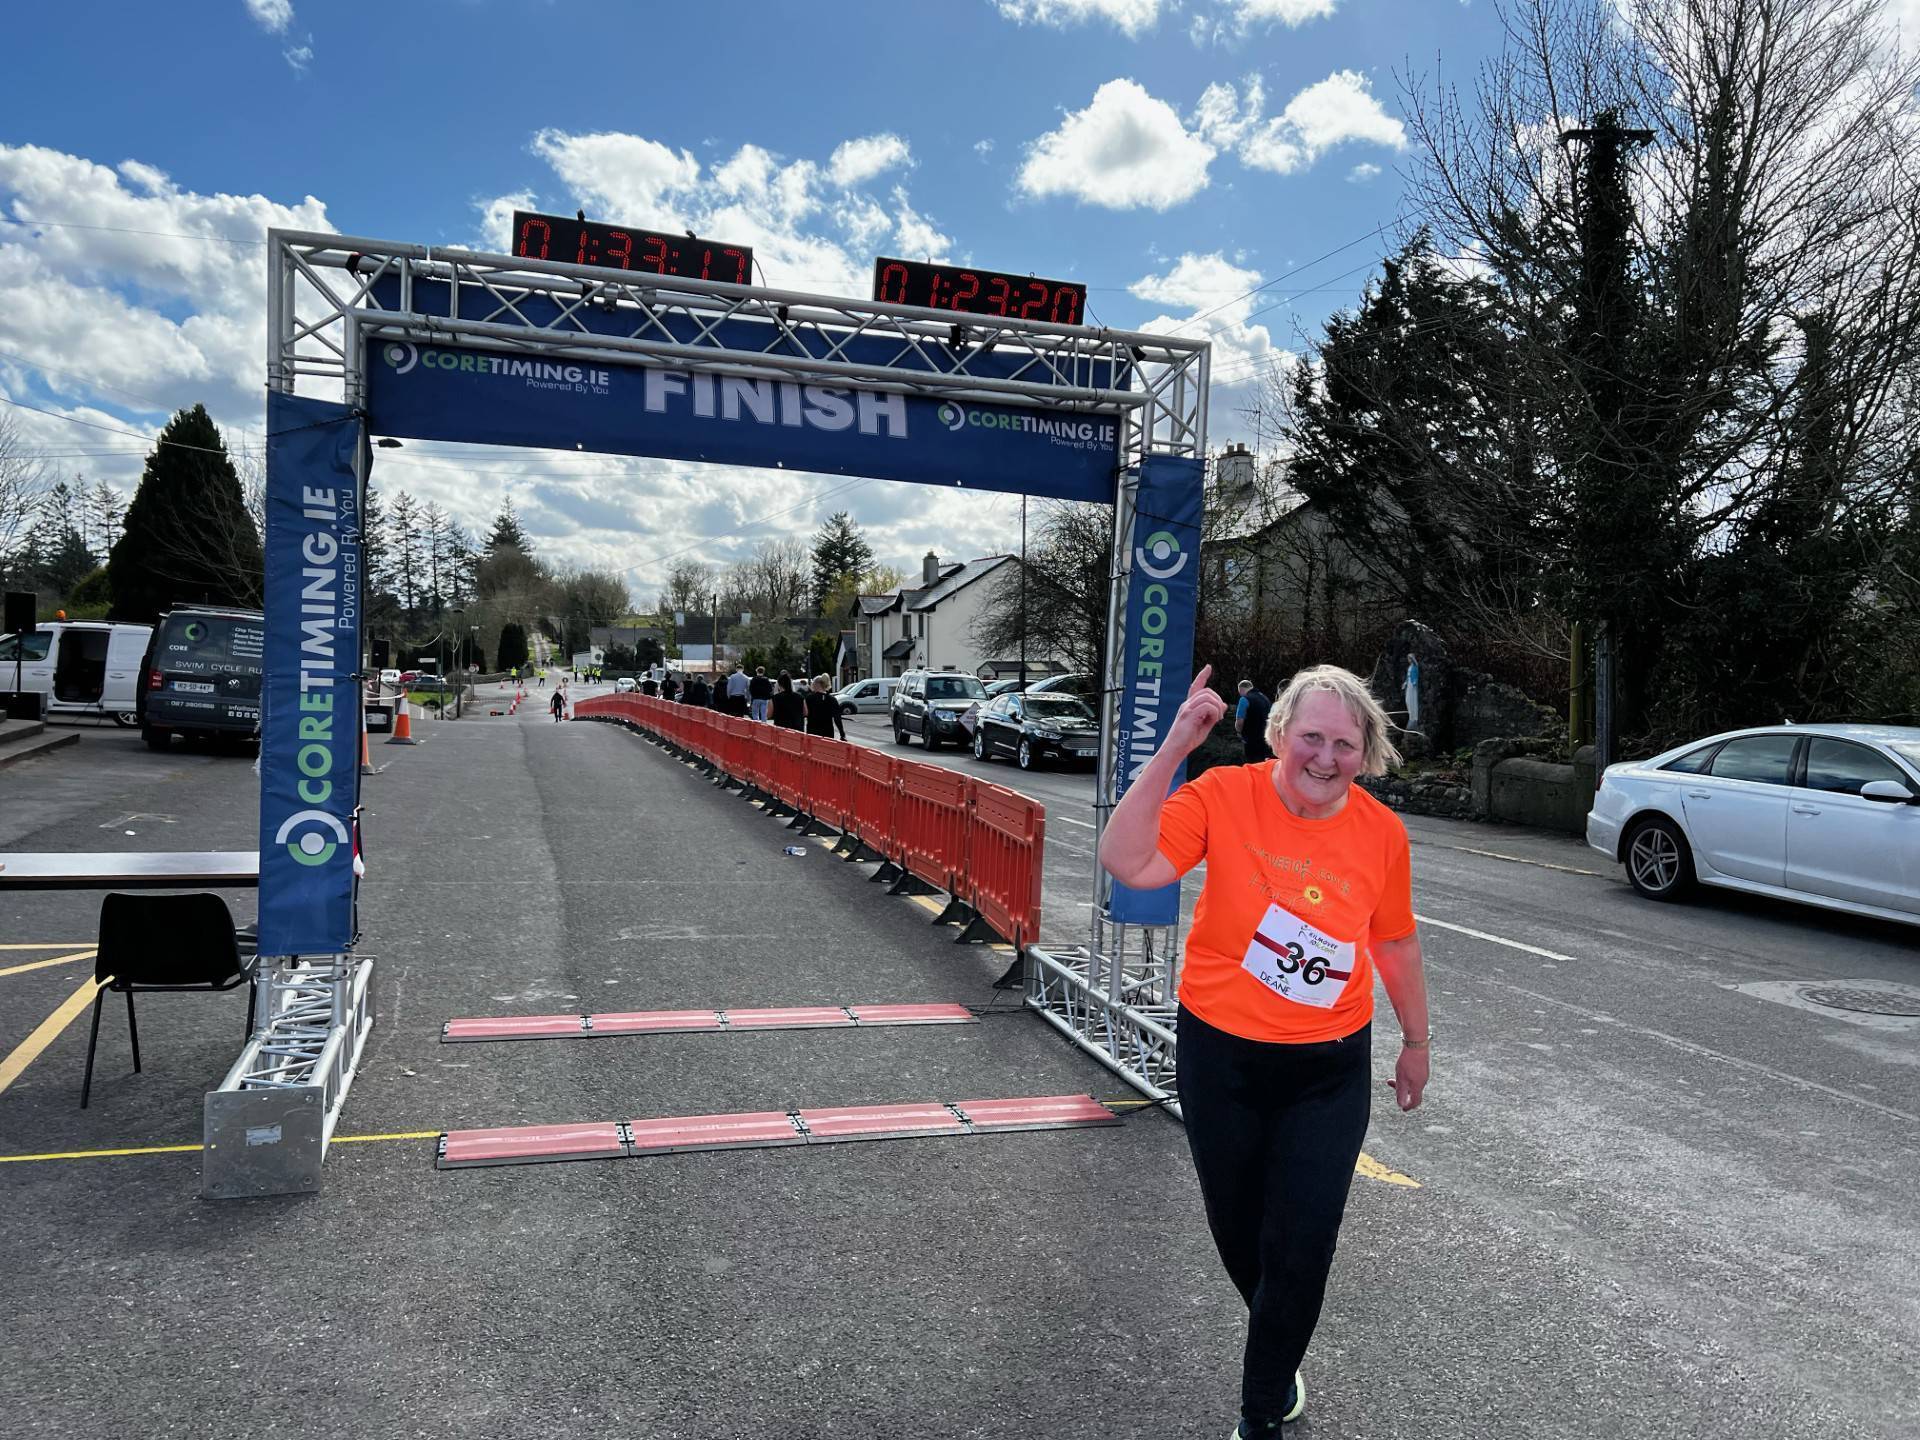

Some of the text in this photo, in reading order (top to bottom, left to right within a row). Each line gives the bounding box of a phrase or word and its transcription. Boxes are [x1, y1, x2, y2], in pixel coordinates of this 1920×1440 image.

[519, 218, 746, 284] 01:33:17
[881, 264, 1080, 324] 01:23:20
[421, 350, 609, 386] CORETIMING.IE
[526, 378, 609, 395] Powered By You
[644, 367, 908, 439] FINISH
[968, 410, 1115, 443] CORETIMING.IE
[1050, 436, 1114, 452] Powered By You
[339, 489, 359, 629] Powered By You
[175, 661, 262, 675] SWIM CYCLE RU
[298, 485, 338, 804] CORETIMING.IE
[1128, 584, 1168, 781] CORETIMIN
[1117, 730, 1129, 794] Powered
[1259, 971, 1291, 996] DEANE
[1276, 941, 1331, 986] 36
